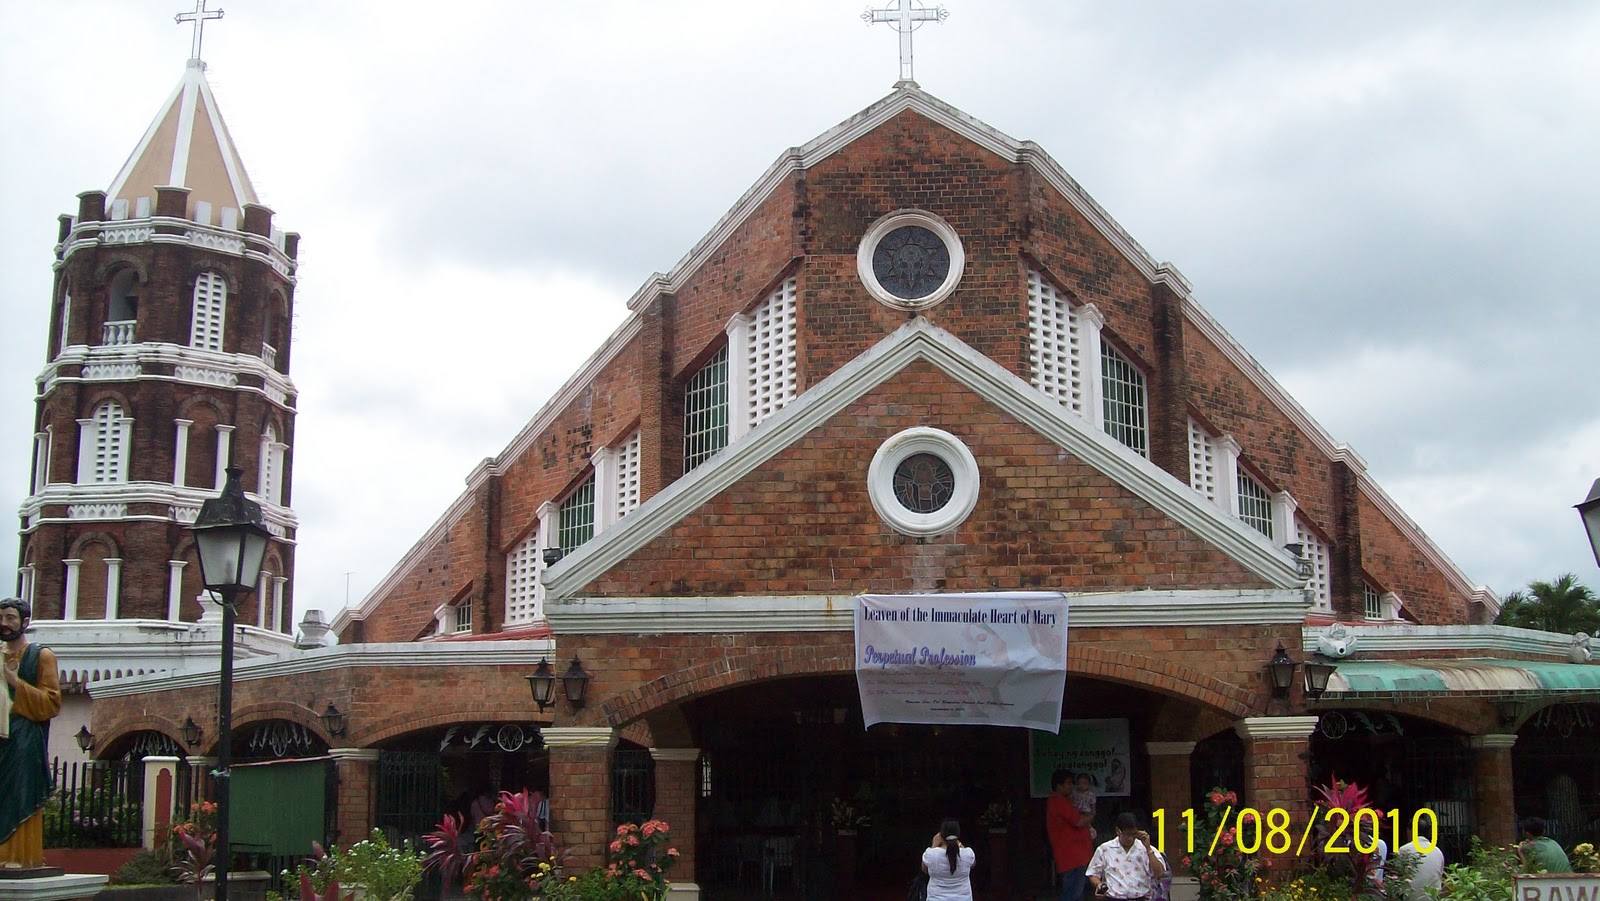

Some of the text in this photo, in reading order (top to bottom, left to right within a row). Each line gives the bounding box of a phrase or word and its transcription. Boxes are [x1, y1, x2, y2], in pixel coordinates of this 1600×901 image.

[864, 606, 1057, 628] Leaven of the Immaculate Heart of Mary
[864, 645, 977, 670] Perpetual Profession
[1066, 750, 1078, 759] ng
